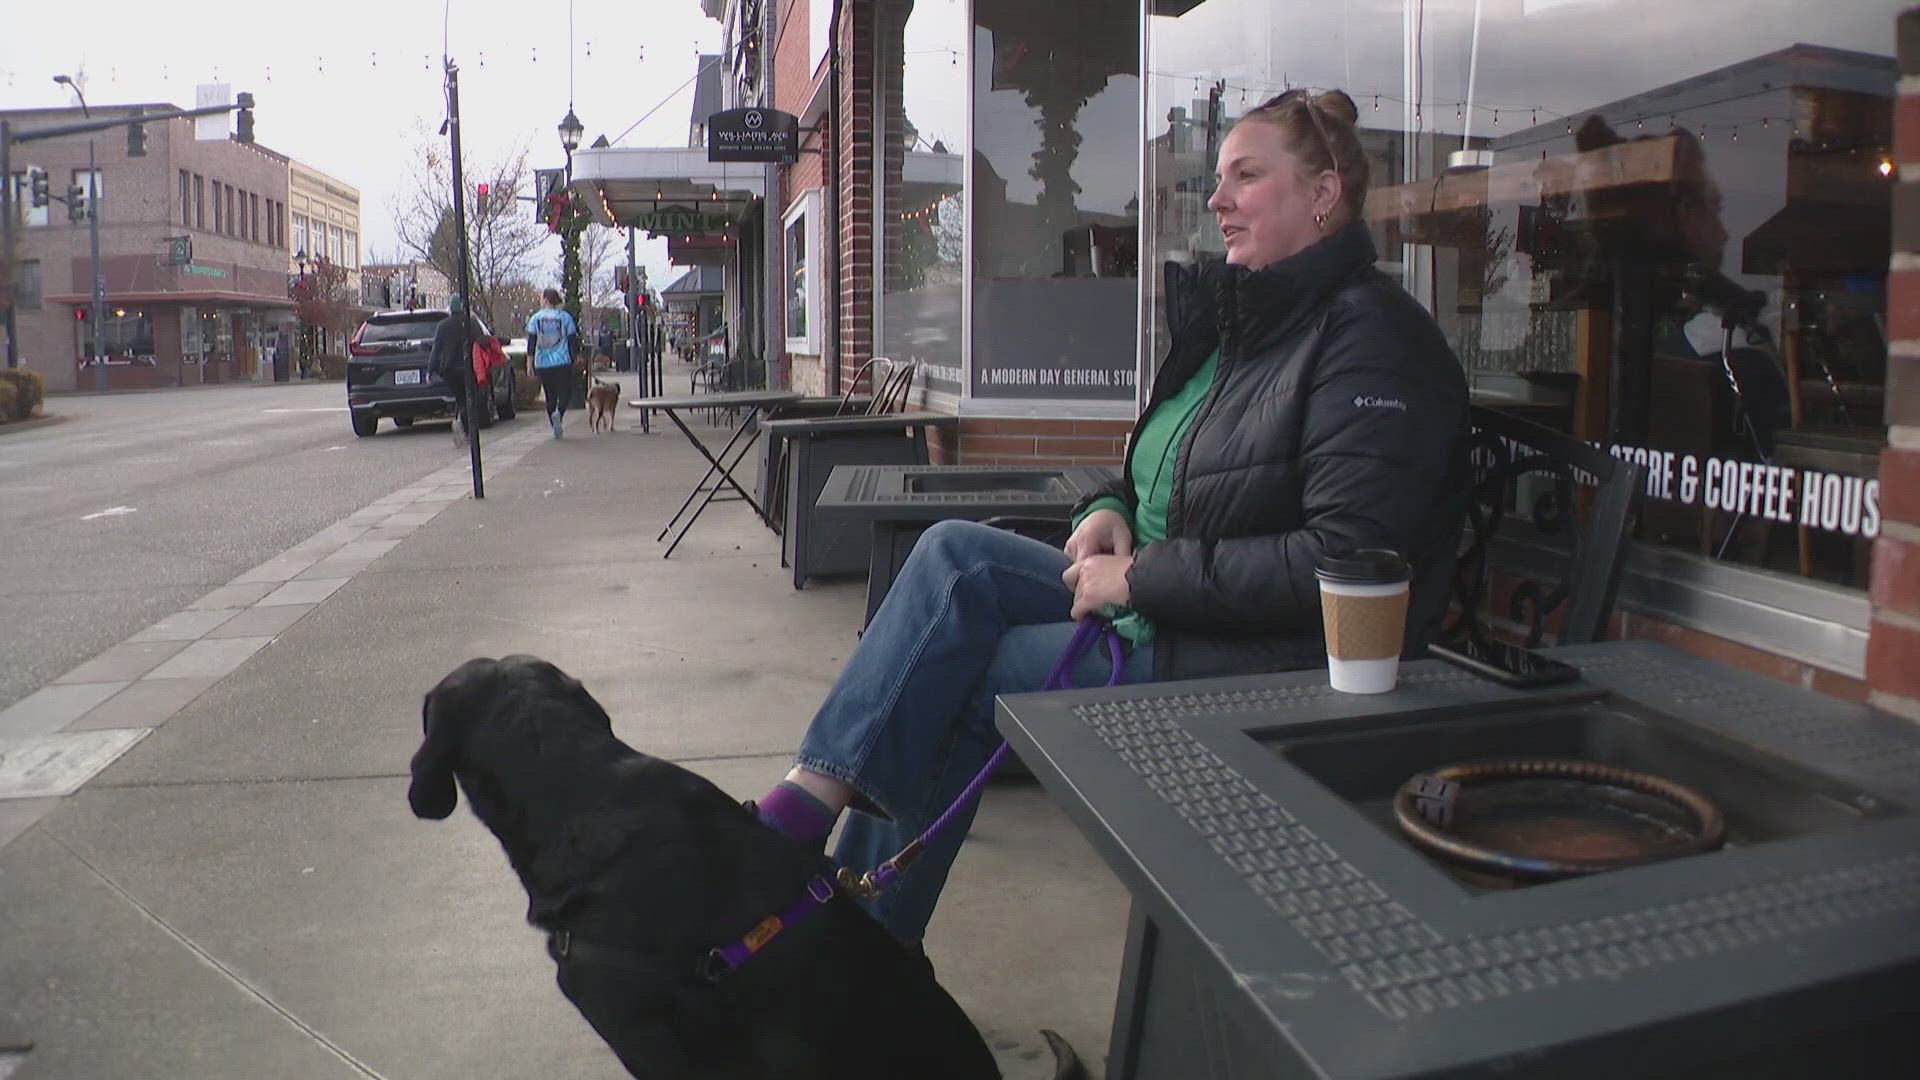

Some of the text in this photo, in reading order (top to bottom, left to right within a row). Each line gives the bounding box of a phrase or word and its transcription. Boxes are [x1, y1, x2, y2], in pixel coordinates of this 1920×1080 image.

[718, 131, 767, 139] WILLIAMS
[638, 212, 716, 231] MINT
[981, 368, 989, 385] A
[991, 369, 1035, 385] MODERN
[1039, 369, 1061, 386] DAY
[1063, 370, 1111, 386] GENERAL
[1364, 396, 1407, 411] Columbia
[1609, 444, 1675, 500] TRE
[1679, 454, 1698, 504] &
[1704, 457, 1795, 522] COFFEE
[1801, 470, 1881, 538] HOUS
